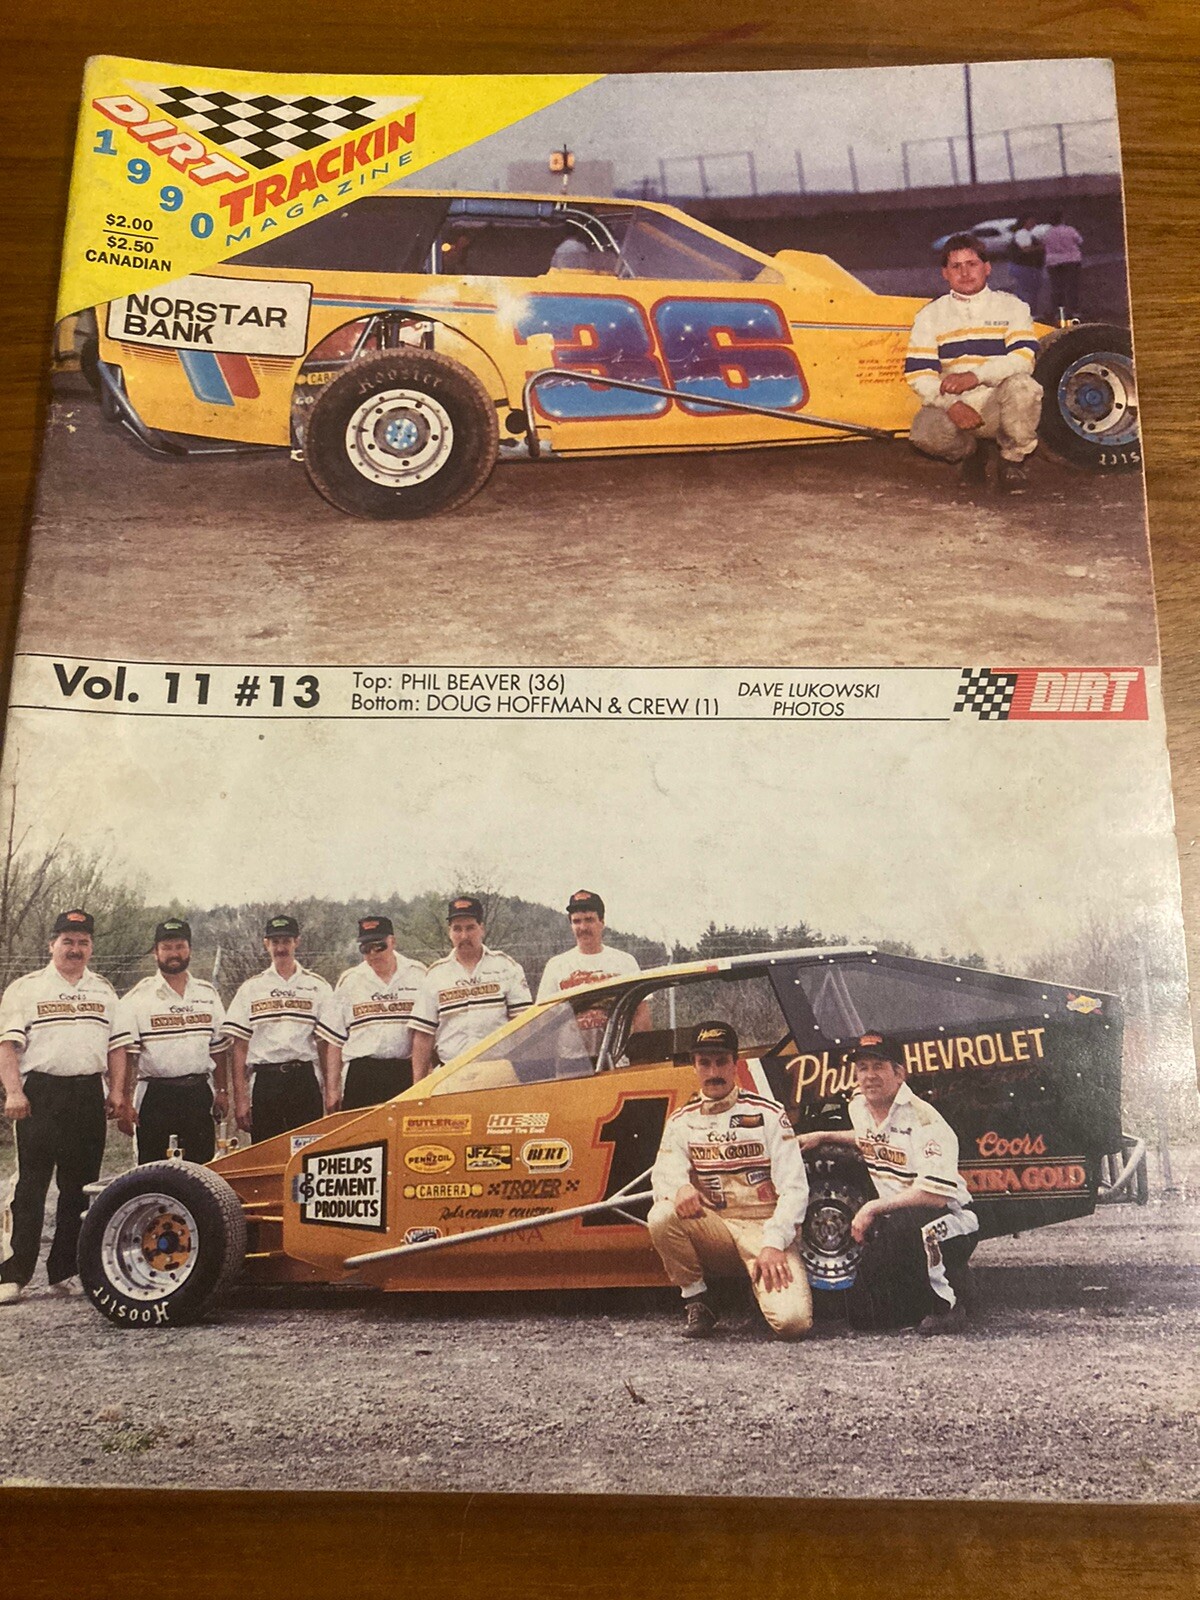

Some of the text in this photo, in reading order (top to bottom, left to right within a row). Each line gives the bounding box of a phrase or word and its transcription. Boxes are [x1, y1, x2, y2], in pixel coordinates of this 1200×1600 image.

[92, 94, 250, 187] DIRT
[219, 112, 416, 227] TRACKIN
[225, 150, 414, 247] MAGAZINE
[105, 213, 154, 233] $2.00
[106, 235, 154, 255] $2.50
[85, 249, 172, 273] CANADIAN
[126, 293, 288, 328] NORSTAR
[123, 315, 214, 344] BANK
[53, 663, 321, 708] Vol. 11 #13
[352, 672, 566, 695] Top: PHIL BEAVER (36)
[738, 682, 880, 699] DAVE LUKOWSKI
[1029, 671, 1139, 713] DIRT
[351, 694, 720, 716] Bottom: DOUG HOFFMAN & CREW (1)
[772, 700, 845, 717] PHOTOS
[903, 1027, 1046, 1074] HEVROLET
[975, 1131, 1048, 1158] Coors
[317, 1156, 373, 1175] PHELPS
[408, 1155, 452, 1165] PENNZOIL
[315, 1177, 377, 1197] CEMENT
[501, 1178, 562, 1197] TROYER
[958, 1164, 1086, 1192] XTRA GOLD
[420, 1184, 467, 1198] CARRERA
[314, 1199, 380, 1219] PRODUCTS
